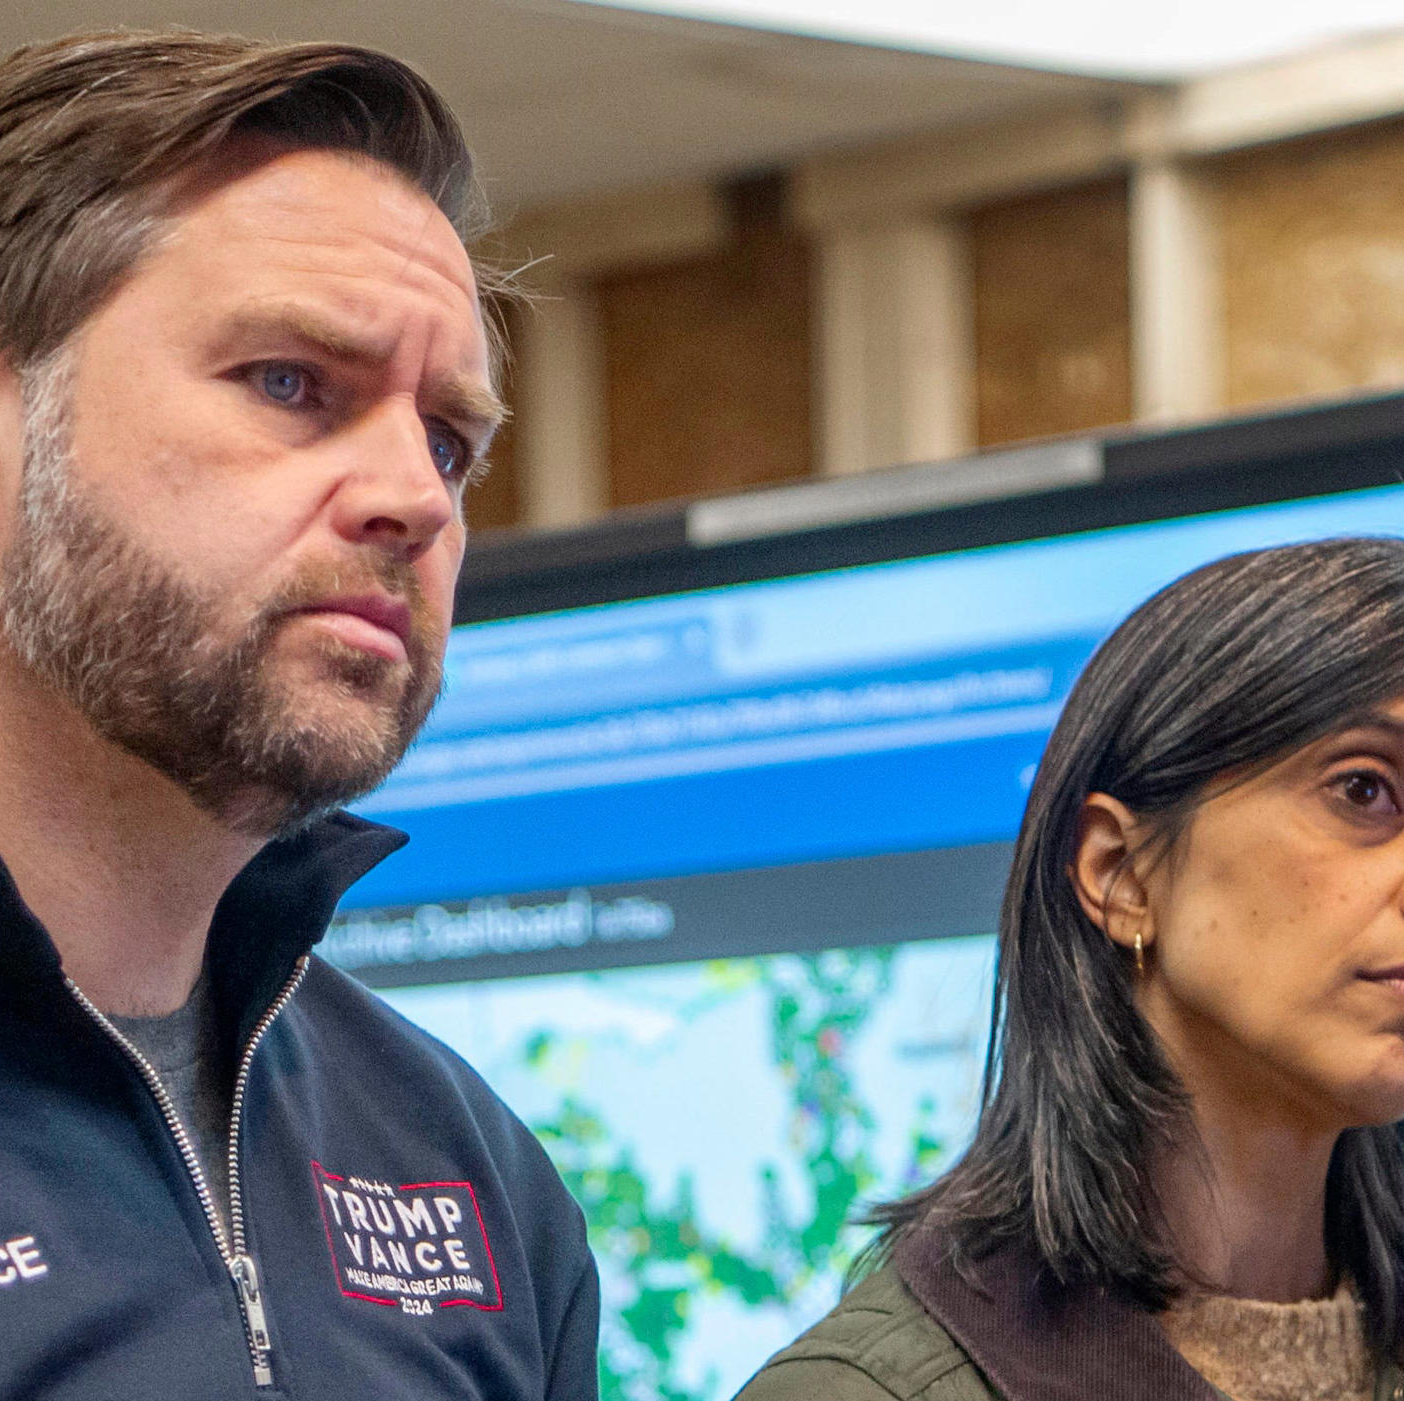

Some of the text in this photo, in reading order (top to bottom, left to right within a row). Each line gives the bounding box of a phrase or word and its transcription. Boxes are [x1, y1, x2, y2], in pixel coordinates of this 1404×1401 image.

[323, 1183, 462, 1238] TRUMP
[343, 1231, 471, 1275] VANCE
[345, 1267, 373, 1288] MAKE
[409, 1276, 452, 1296] GREAT
[400, 1296, 434, 1316] 2024
